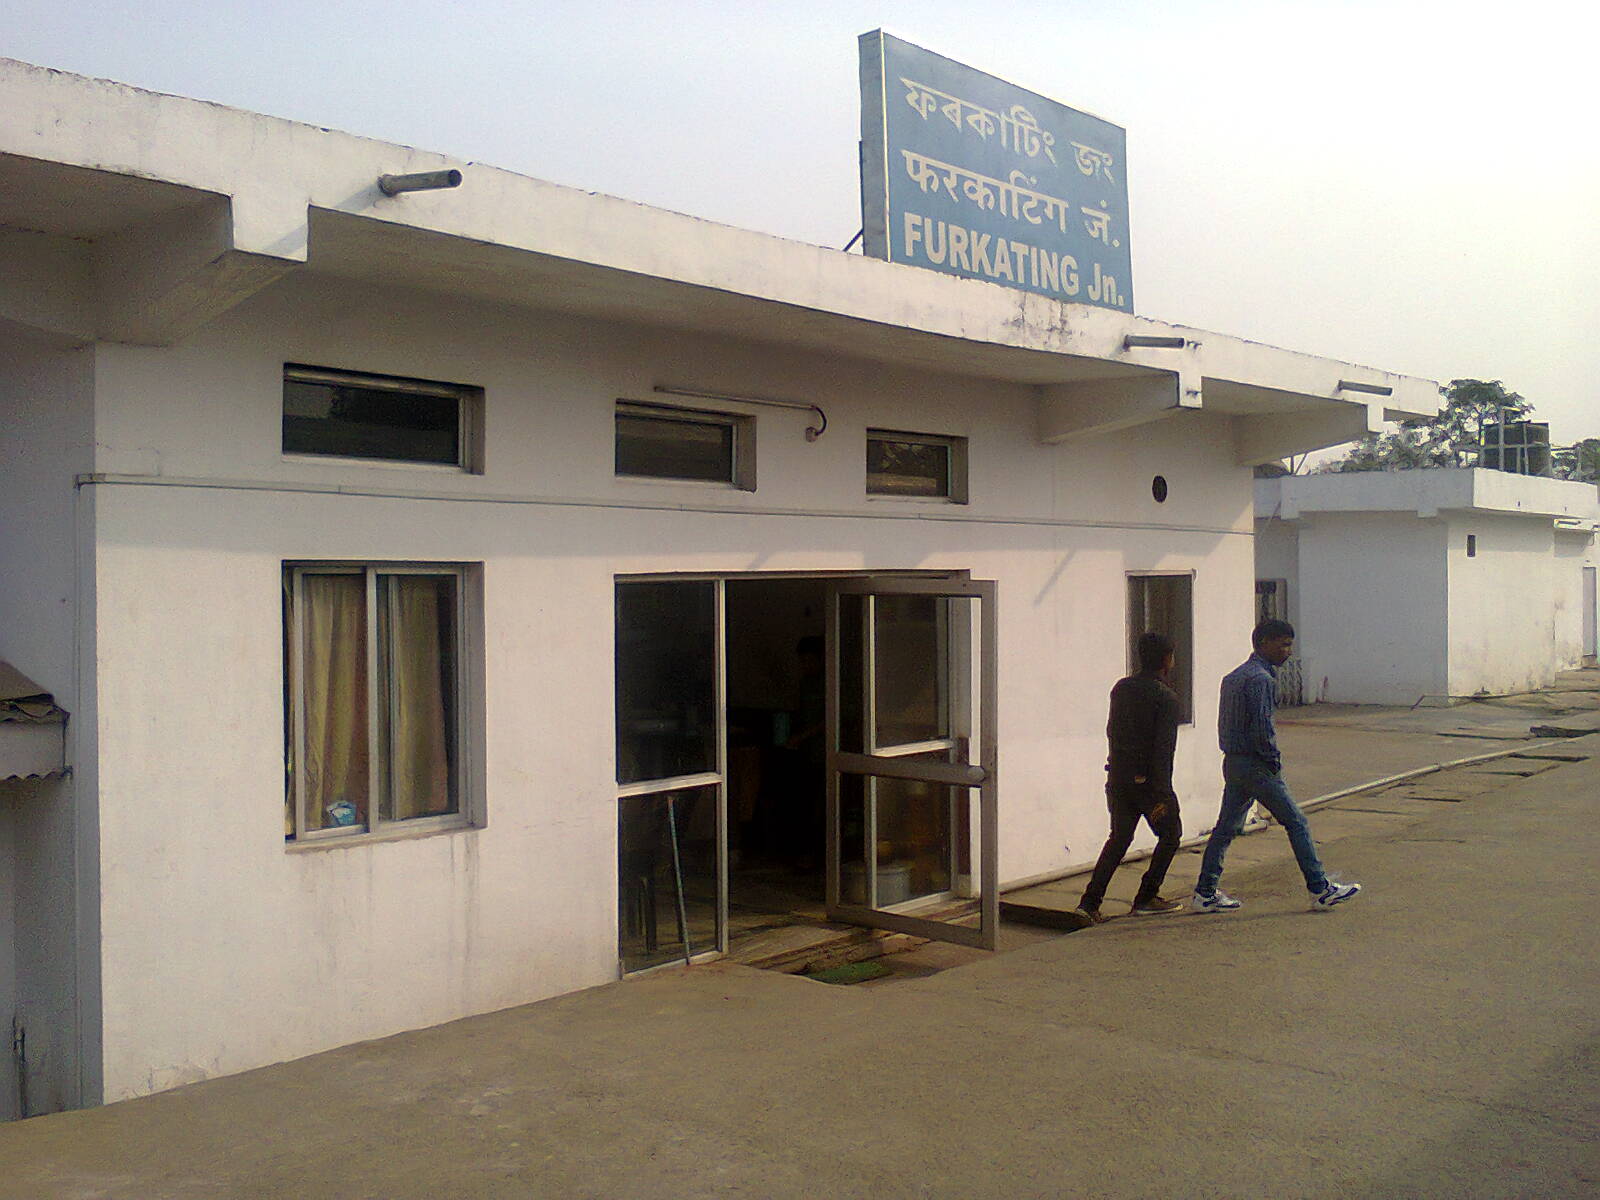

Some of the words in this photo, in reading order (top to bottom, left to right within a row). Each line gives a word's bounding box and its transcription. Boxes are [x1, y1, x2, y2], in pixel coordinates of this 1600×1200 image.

[901, 149, 1070, 233] फरकाटिंग
[1070, 141, 1115, 184] জং
[904, 212, 1080, 296] FURKATING
[1088, 263, 1125, 306] Jn.
